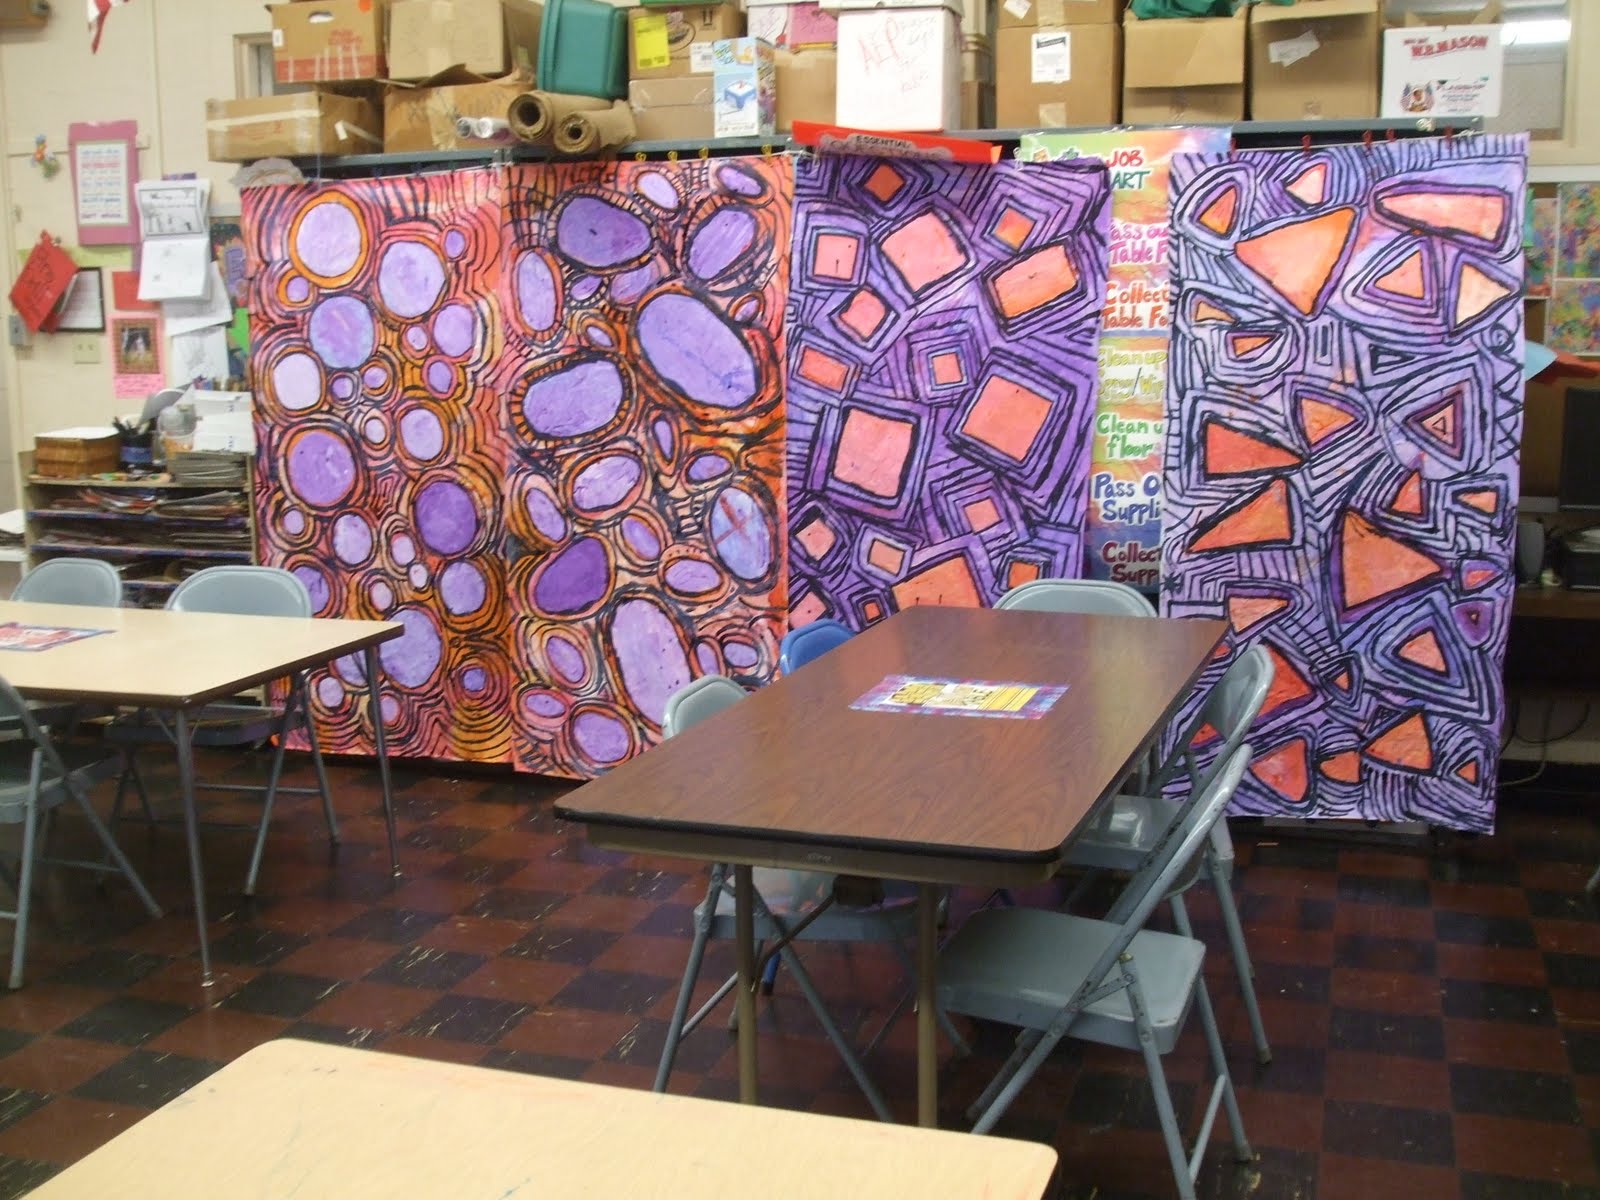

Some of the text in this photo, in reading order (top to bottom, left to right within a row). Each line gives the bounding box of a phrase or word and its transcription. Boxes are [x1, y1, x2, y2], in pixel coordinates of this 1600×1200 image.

[1106, 149, 1144, 168] JOB
[1110, 222, 1142, 241] ass
[1110, 242, 1151, 265] Table
[1105, 282, 1168, 305] Collect
[1101, 306, 1144, 328] Table
[1096, 414, 1148, 435] Clean
[1107, 434, 1153, 458] floor
[1094, 473, 1135, 499] Pass
[1103, 499, 1160, 524] Suppli
[1111, 563, 1159, 584] Supp
